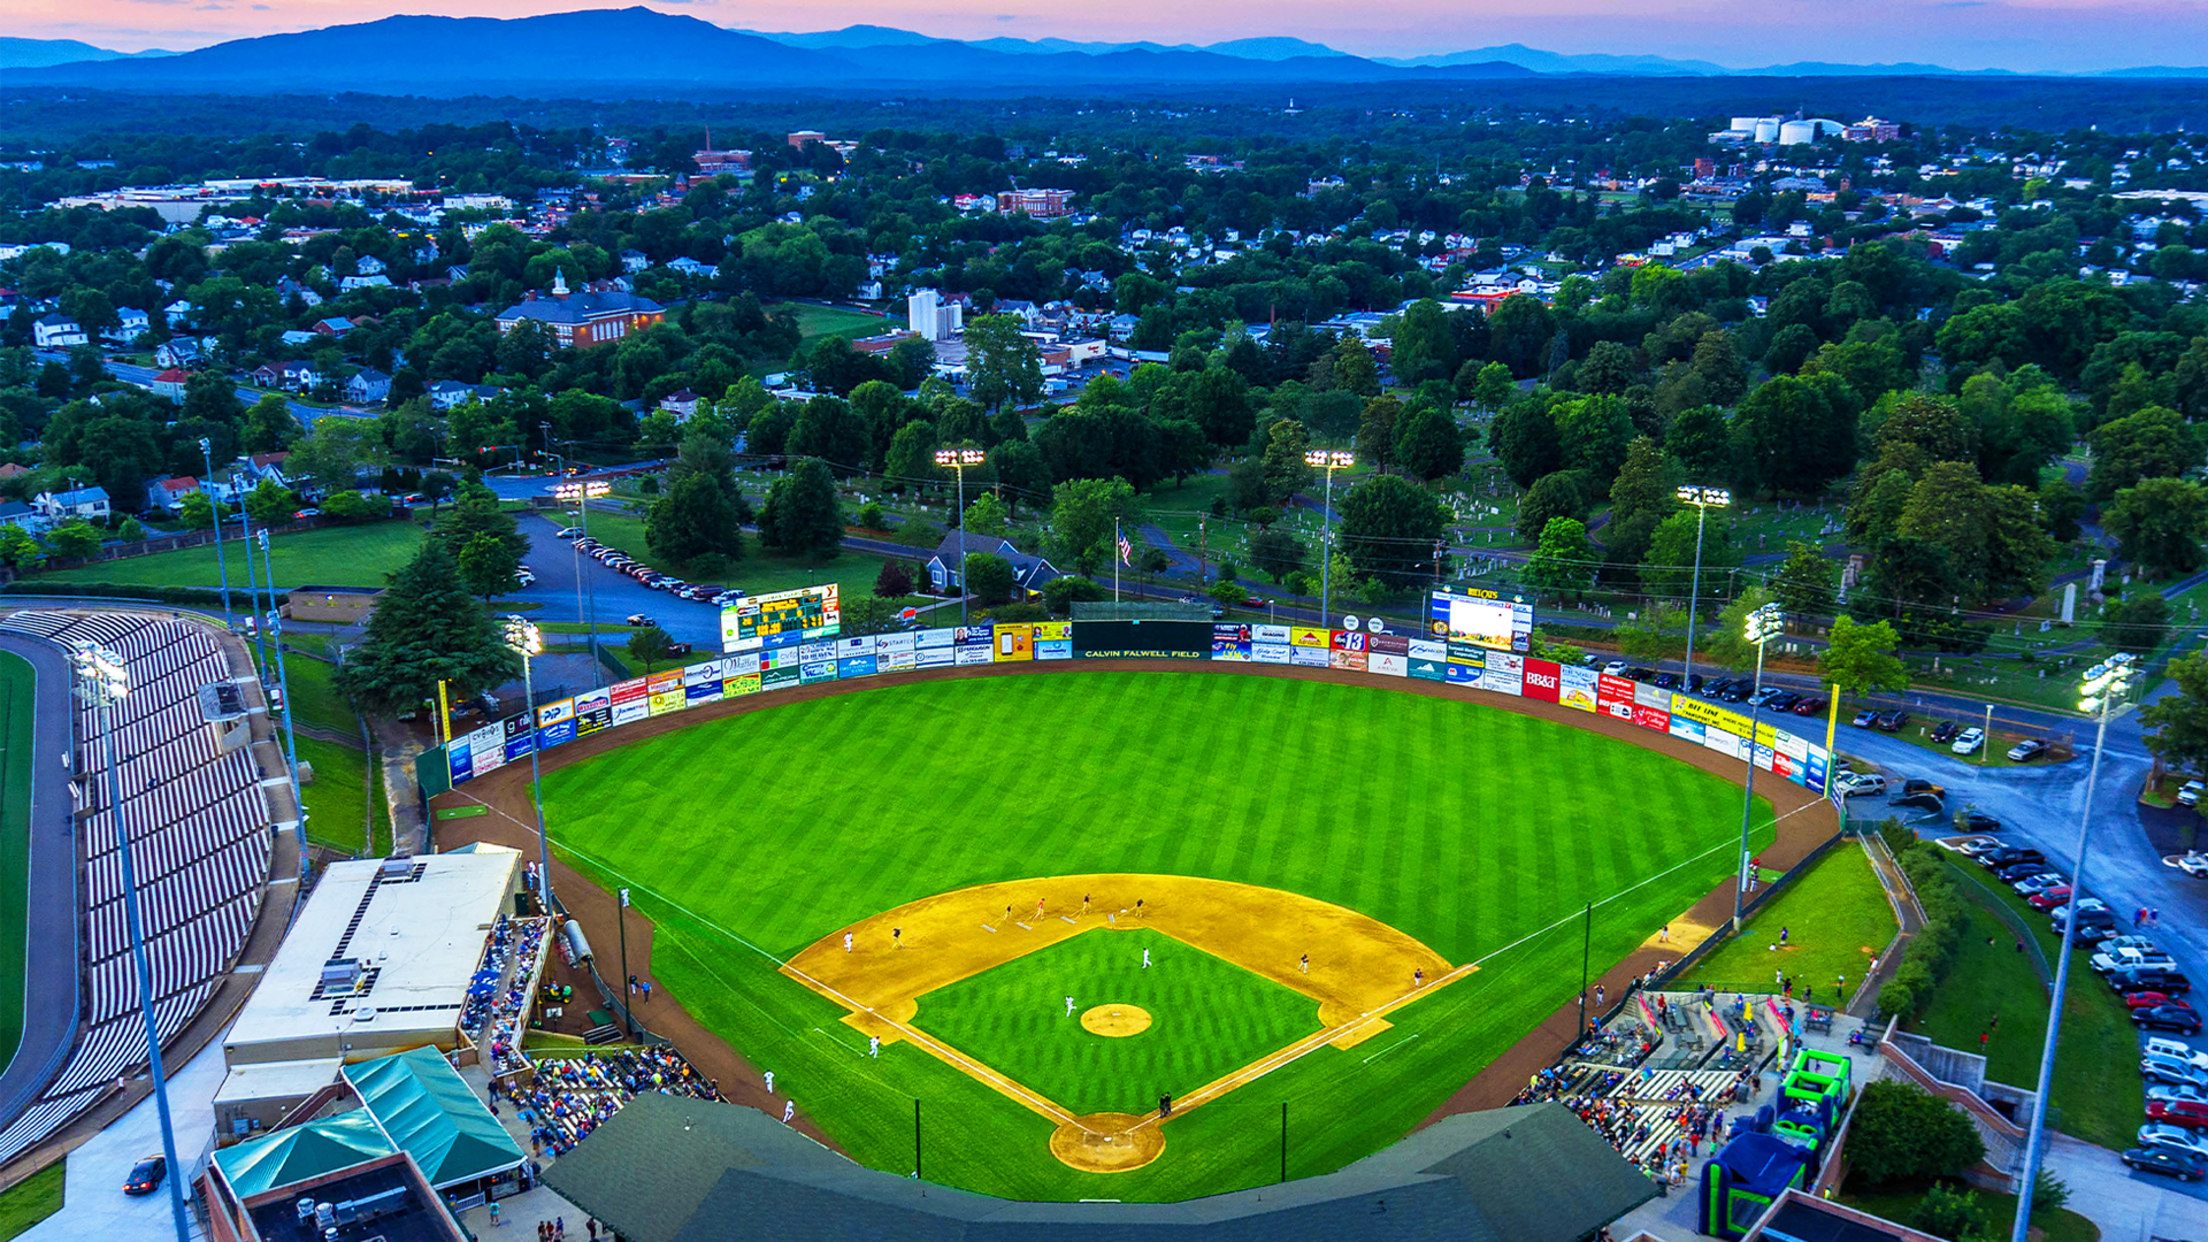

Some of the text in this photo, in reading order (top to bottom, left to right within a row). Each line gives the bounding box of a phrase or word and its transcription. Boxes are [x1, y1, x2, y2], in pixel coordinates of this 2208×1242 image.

[1344, 632, 1364, 651] 13
[1085, 650, 1200, 658] CALVIN FALWELL FIELD
[1526, 671, 1558, 689] BB&T
